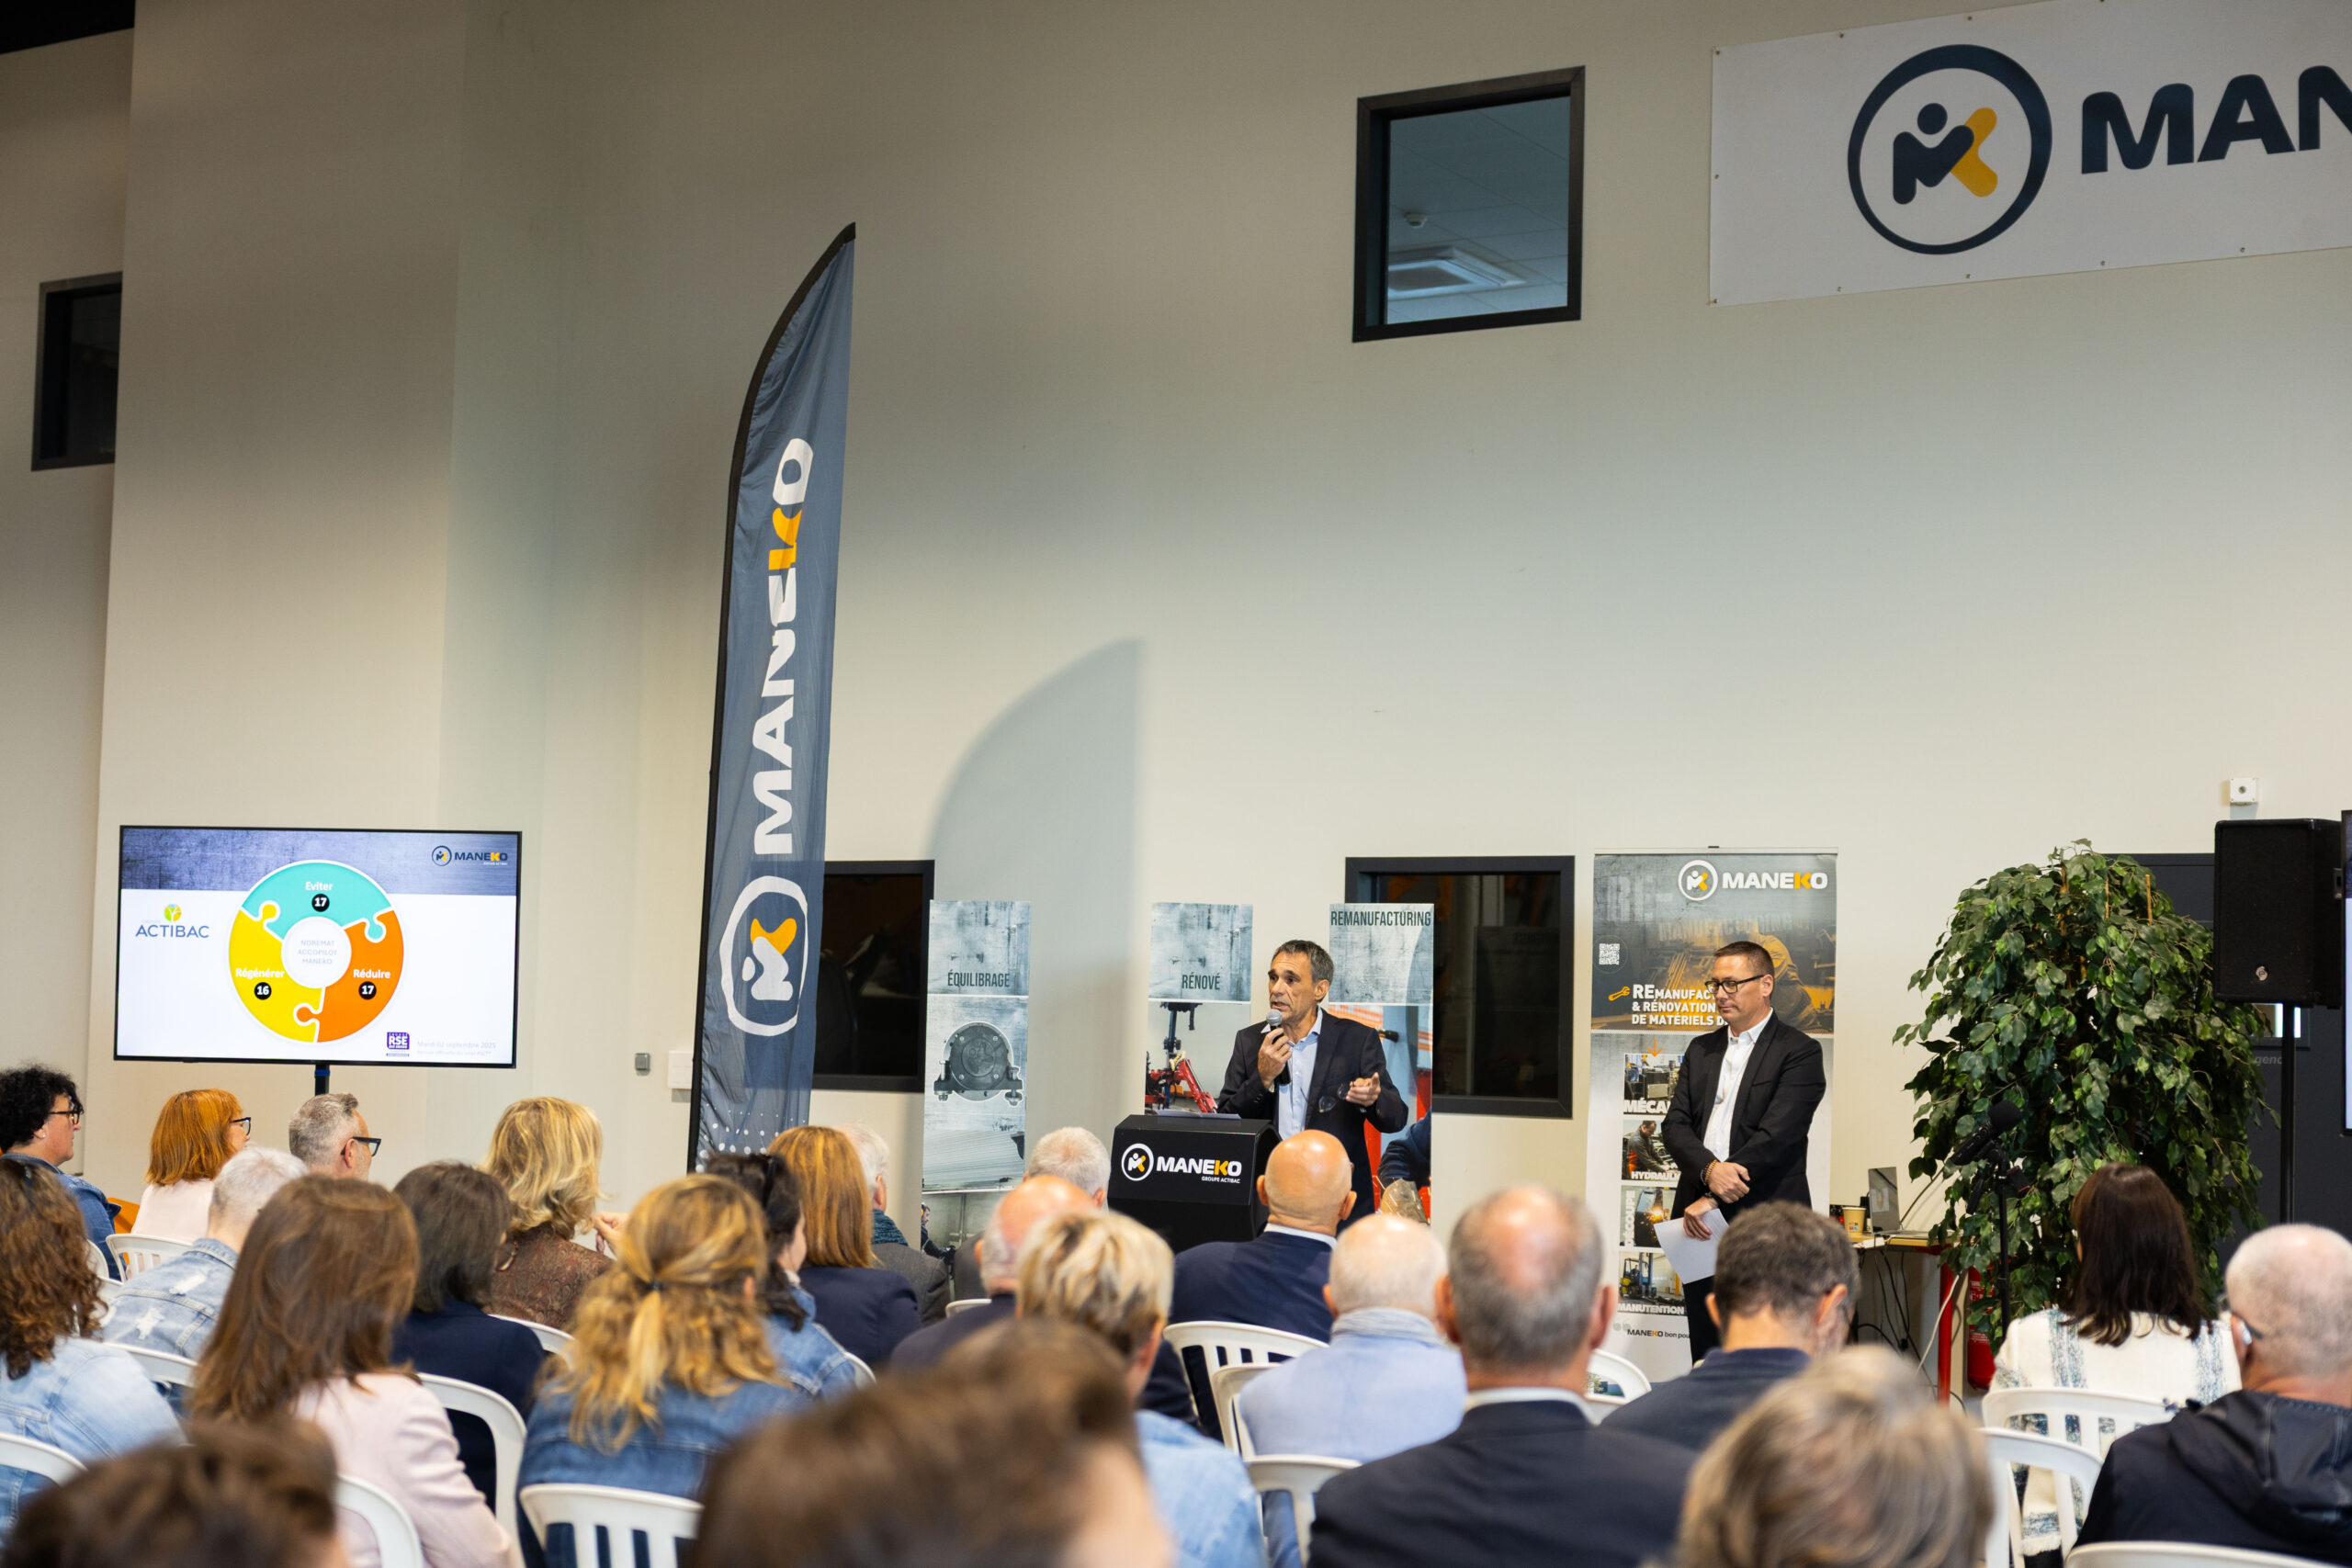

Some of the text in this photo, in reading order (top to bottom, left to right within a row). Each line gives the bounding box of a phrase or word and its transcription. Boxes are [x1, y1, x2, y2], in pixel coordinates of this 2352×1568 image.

[454, 852, 508, 862] MANEKO
[305, 881, 334, 891] Eviter
[1722, 872, 1828, 890] MANEKO
[313, 897, 328, 908] 17
[1330, 910, 1431, 927] REMANUFACTURING
[135, 924, 209, 939] ACTIBAC
[235, 967, 285, 980] Régénérer
[353, 968, 391, 979] Réduire
[947, 968, 1011, 988] ÉQUILIBRAGE
[1182, 971, 1221, 990] RÉNOVÉ
[256, 986, 270, 996] 16
[361, 985, 375, 995] 17
[1632, 999, 1716, 1013] & RÉNOVATION
[1631, 1012, 1729, 1026] DE MATÉRIELS D
[389, 1035, 408, 1045] RSE
[1156, 1156, 1243, 1177] MANEKO
[1623, 1190, 1635, 1247] DÉCOUPE
[1617, 1303, 1685, 1315] MANUTENTION
[1627, 1328, 1664, 1337] MANEKO
